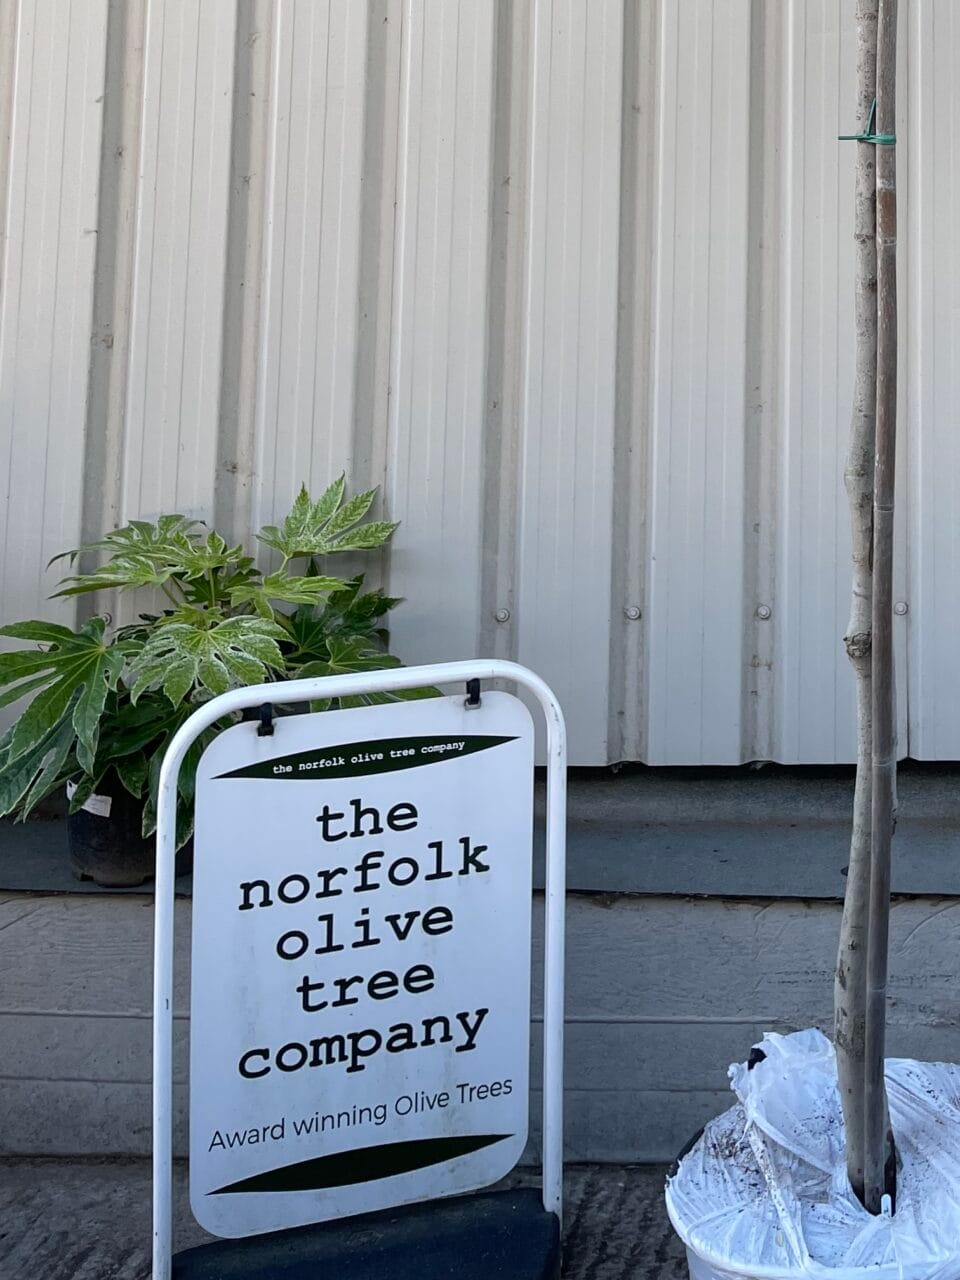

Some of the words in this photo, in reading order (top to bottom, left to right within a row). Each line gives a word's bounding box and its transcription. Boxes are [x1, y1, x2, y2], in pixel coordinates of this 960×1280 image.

[273, 764, 293, 774] the
[298, 757, 346, 771] norfolk
[350, 752, 384, 764] olive
[389, 747, 416, 758] tree
[420, 740, 465, 755] company
[316, 799, 418, 842] the
[238, 837, 490, 911] norfolk
[276, 906, 454, 961] olive
[296, 963, 436, 1013] tree
[238, 1007, 489, 1080] company
[207, 1113, 285, 1153] Award
[291, 1102, 388, 1136] winning
[394, 1089, 450, 1117] Olive
[456, 1078, 513, 1105] Trees
